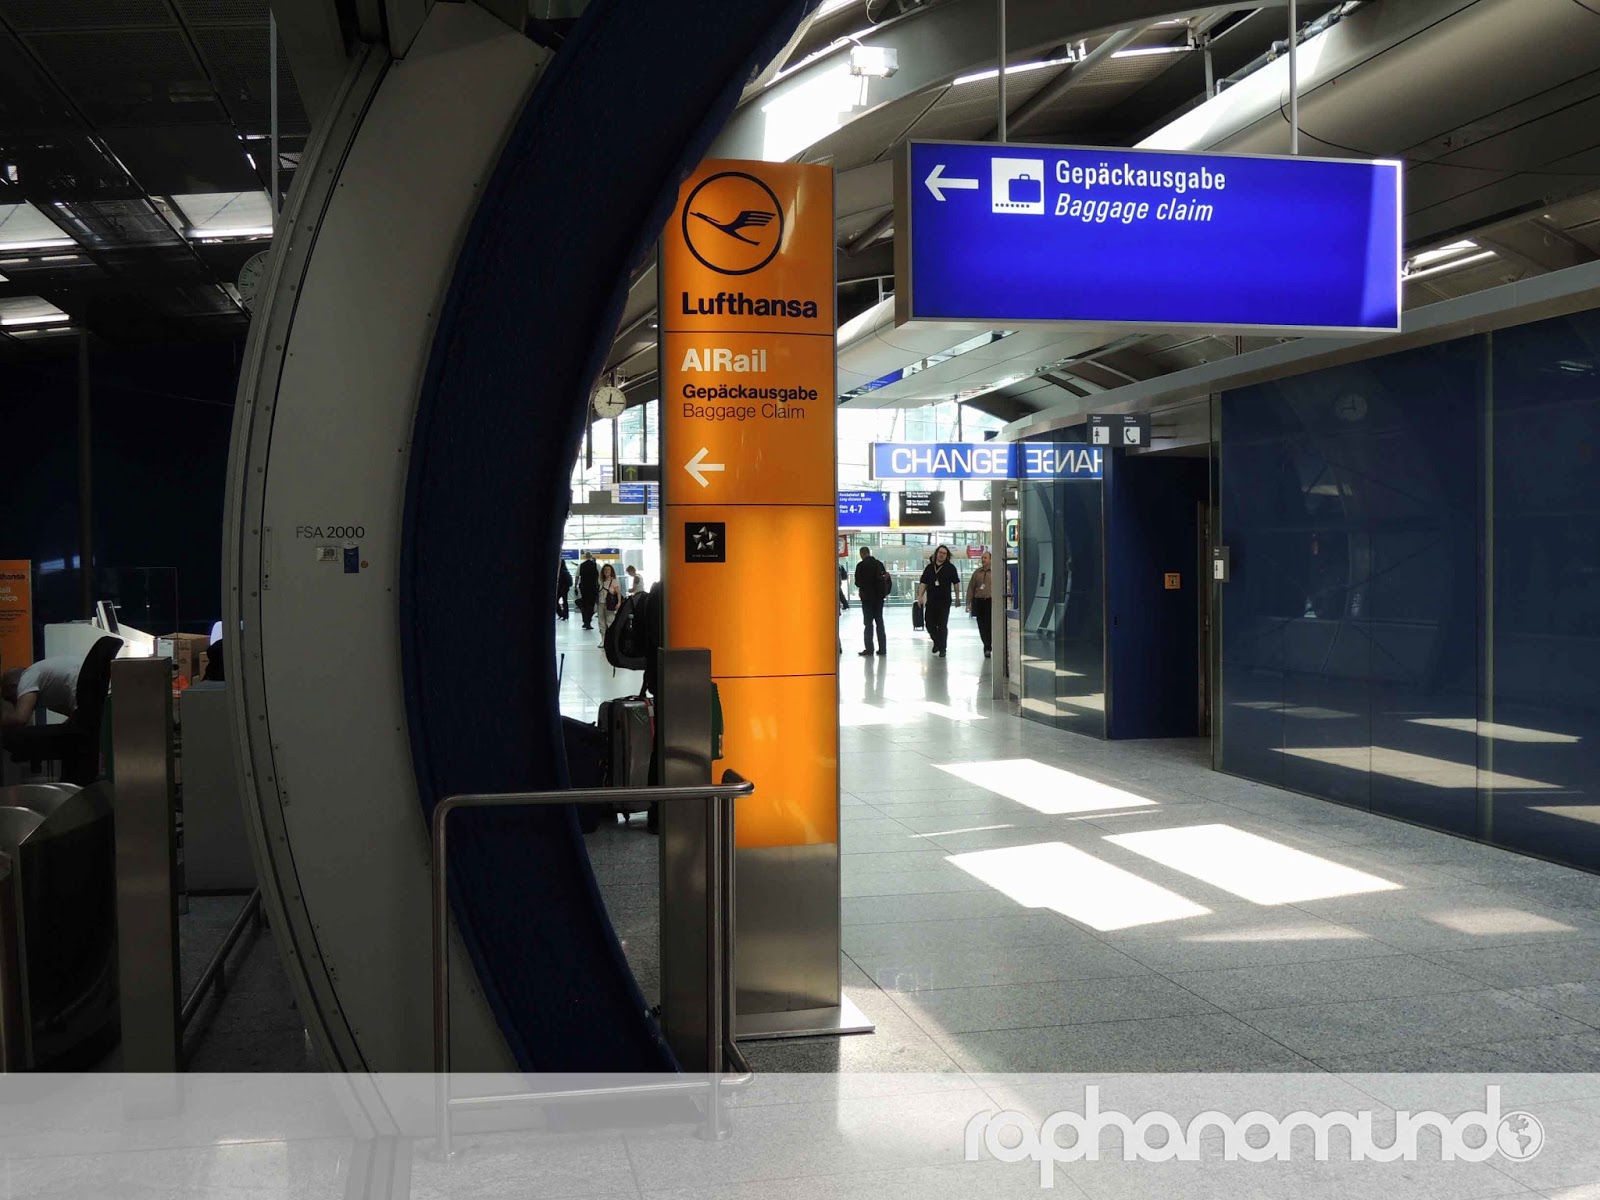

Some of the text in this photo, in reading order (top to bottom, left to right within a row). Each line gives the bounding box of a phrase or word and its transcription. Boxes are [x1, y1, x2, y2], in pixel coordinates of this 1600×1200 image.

[1055, 159, 1226, 194] Gepäckausgabe
[1054, 192, 1214, 224] Baggage claim
[682, 291, 818, 318] Lufthansa
[682, 383, 818, 402] Gepäckausgabe
[683, 403, 805, 422] Baggage Claim
[891, 447, 1008, 474] CHANGE
[849, 504, 863, 514] 4-7
[296, 526, 365, 538] FSA 2000
